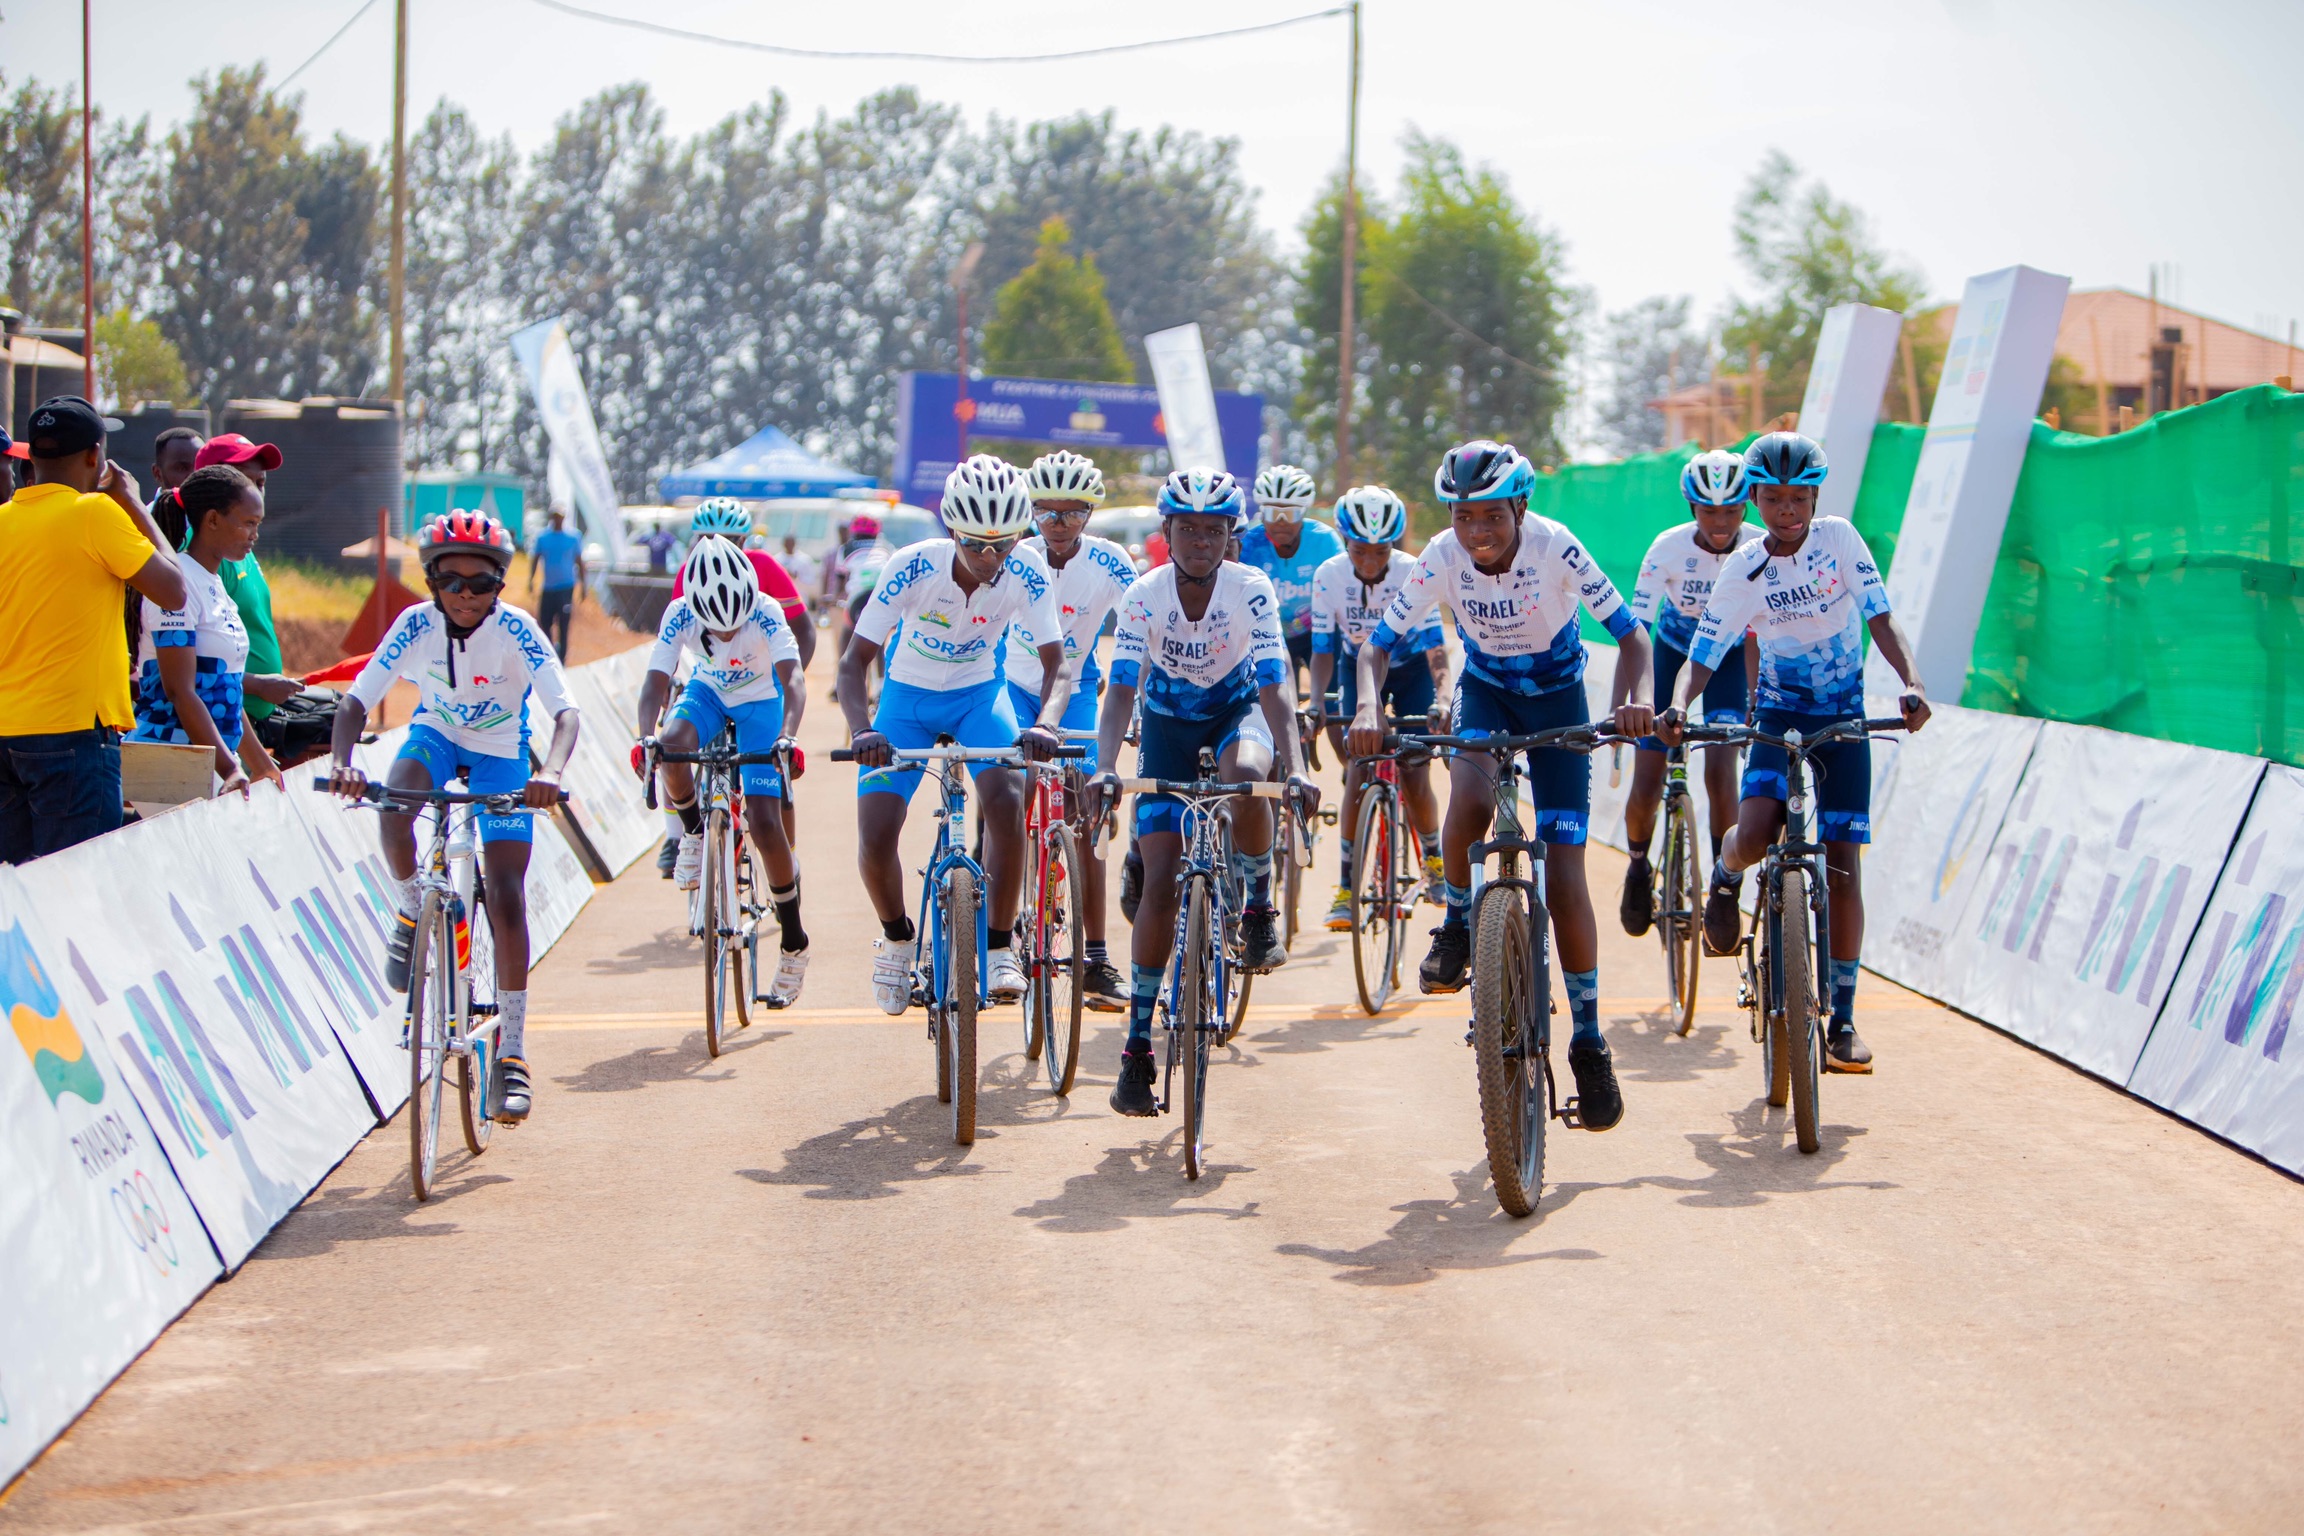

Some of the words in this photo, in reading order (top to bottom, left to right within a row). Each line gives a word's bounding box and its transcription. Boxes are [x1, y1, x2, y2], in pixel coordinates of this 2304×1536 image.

[1682, 580, 1715, 594] ISRA
[1764, 583, 1817, 612] ISRAEL
[1461, 599, 1519, 619] ISRAEL
[1162, 636, 1209, 660] ISRAEL
[1181, 659, 1216, 670] PREMIER
[488, 816, 527, 831] FORZZA
[1555, 820, 1579, 832] JINGA
[1848, 820, 1870, 832] JINGA
[1175, 904, 1188, 958] TREK
[1212, 906, 1221, 960] TREK
[70, 1108, 139, 1180] RWANDA
